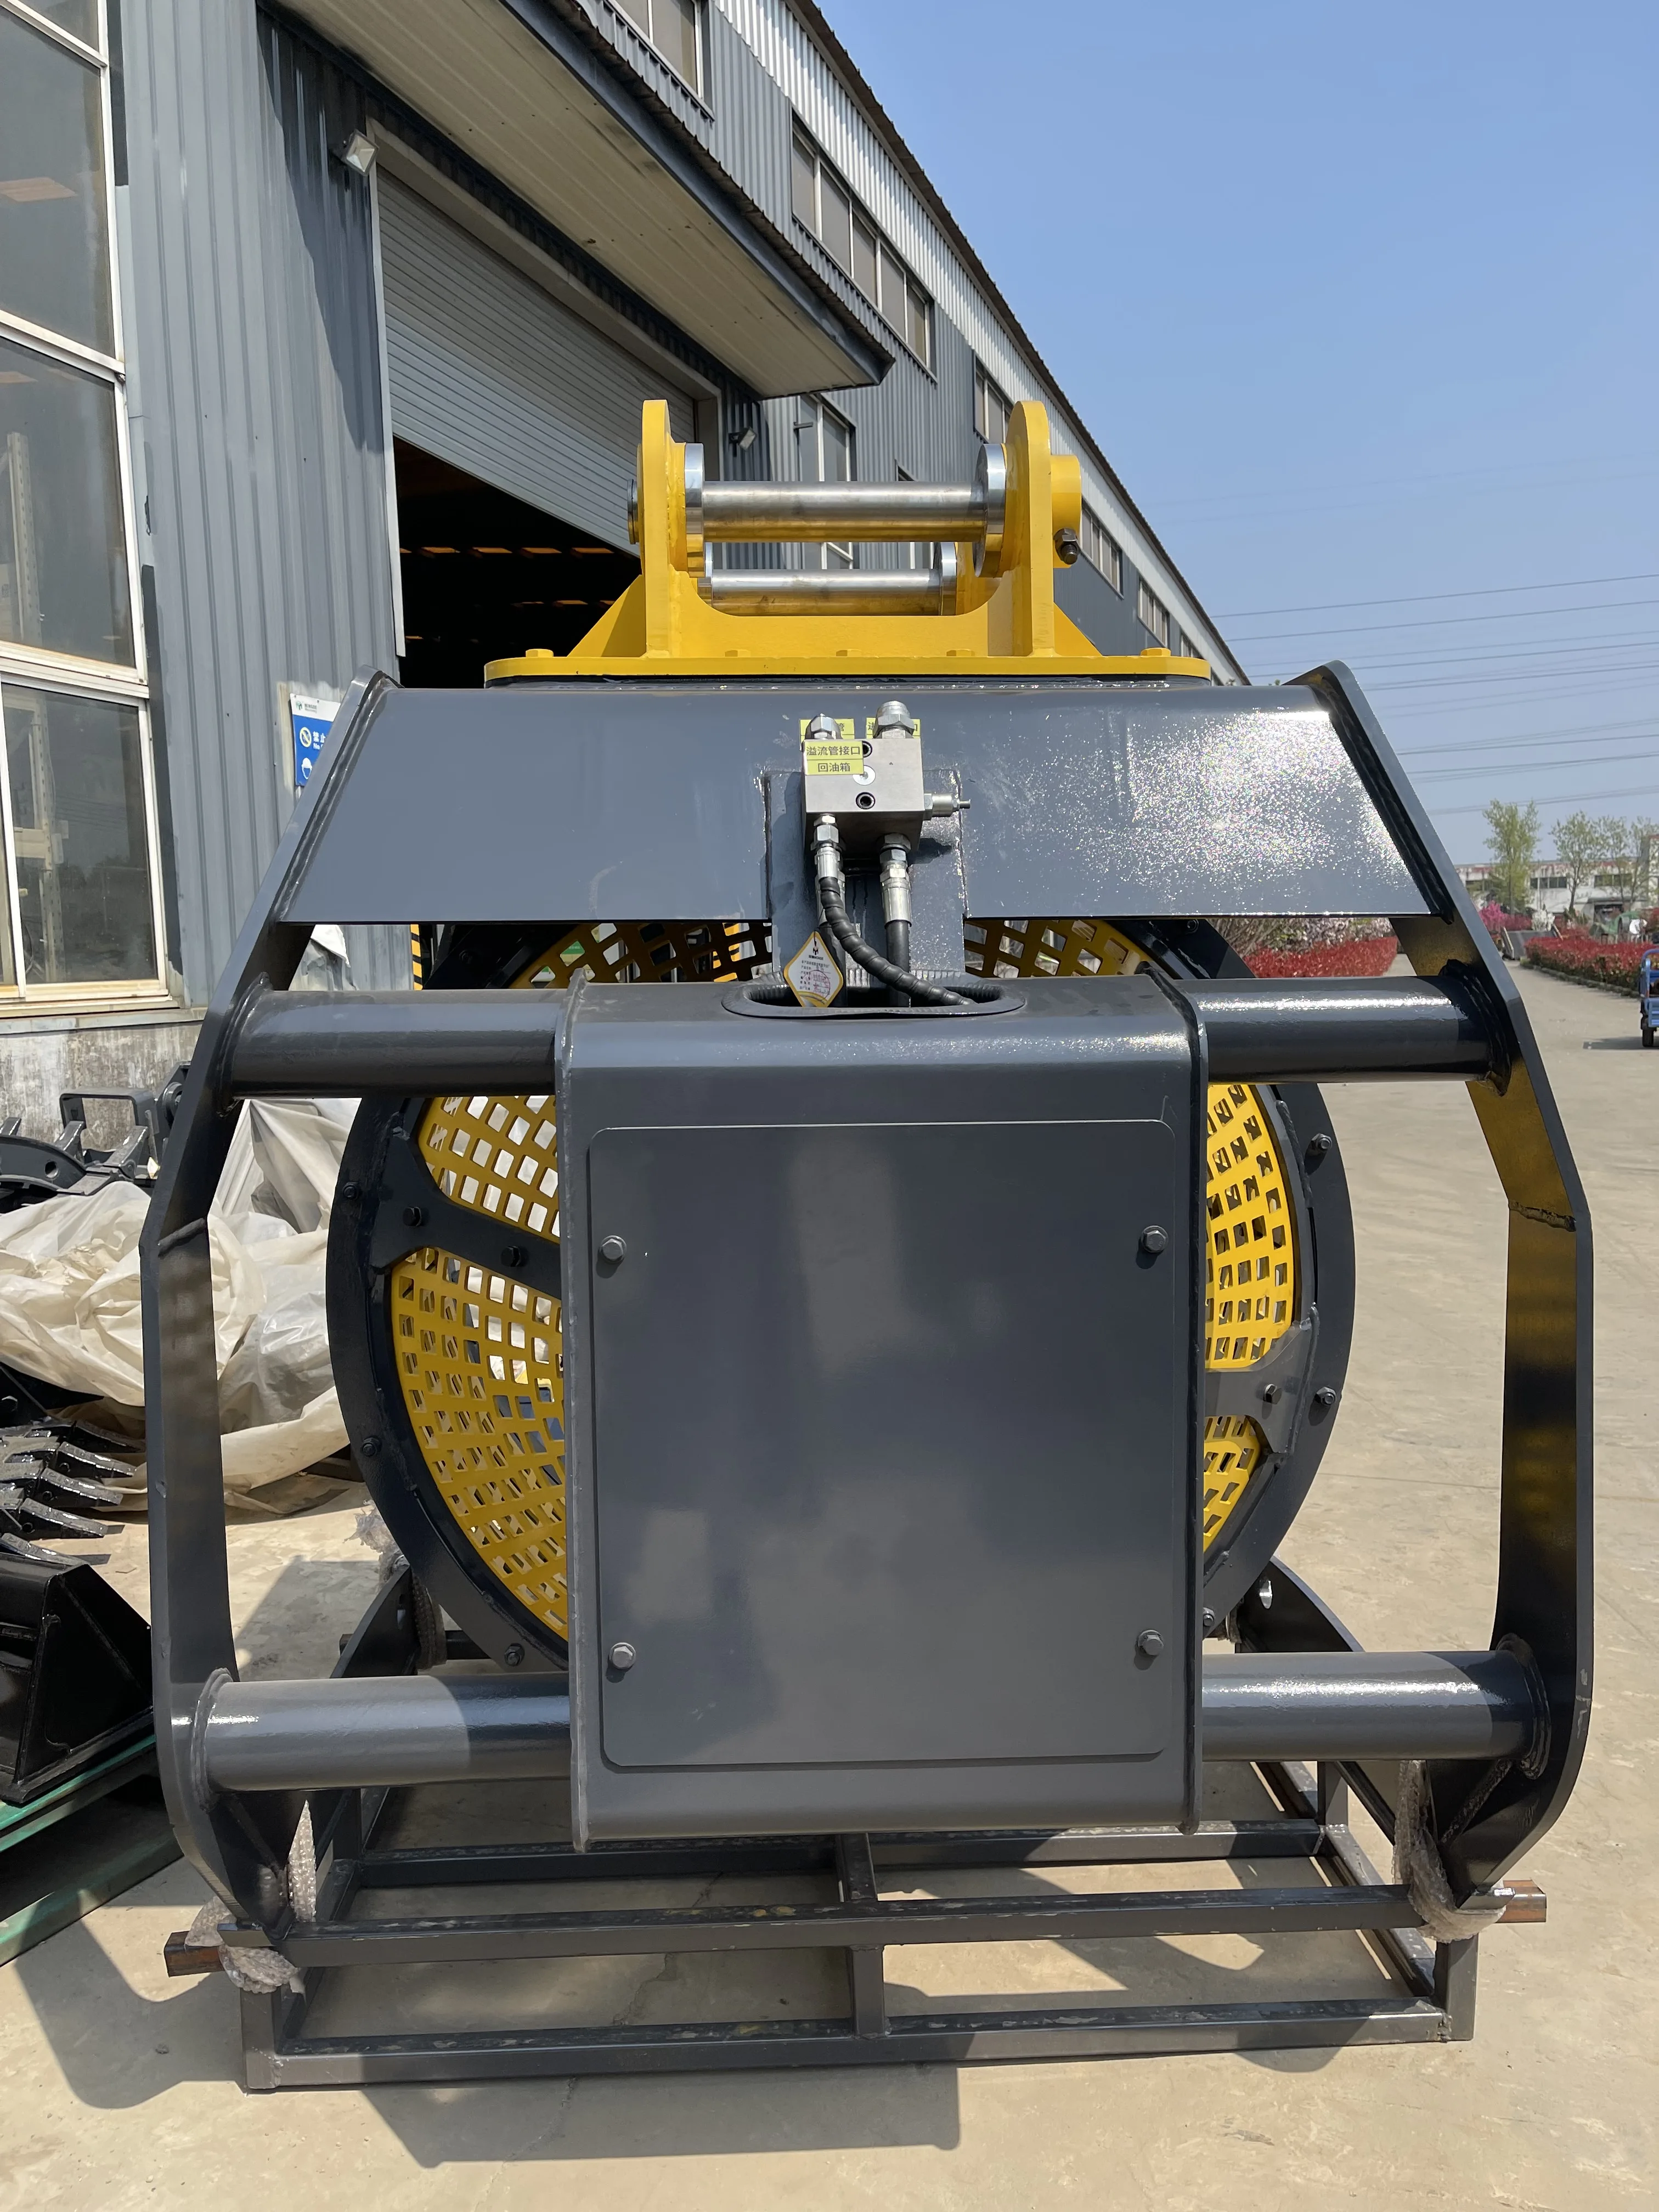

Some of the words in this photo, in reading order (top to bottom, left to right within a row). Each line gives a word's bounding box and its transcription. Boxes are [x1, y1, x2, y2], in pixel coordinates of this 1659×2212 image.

[806, 746, 860, 755] 溢流管接口
[818, 762, 850, 772] 回油箱
